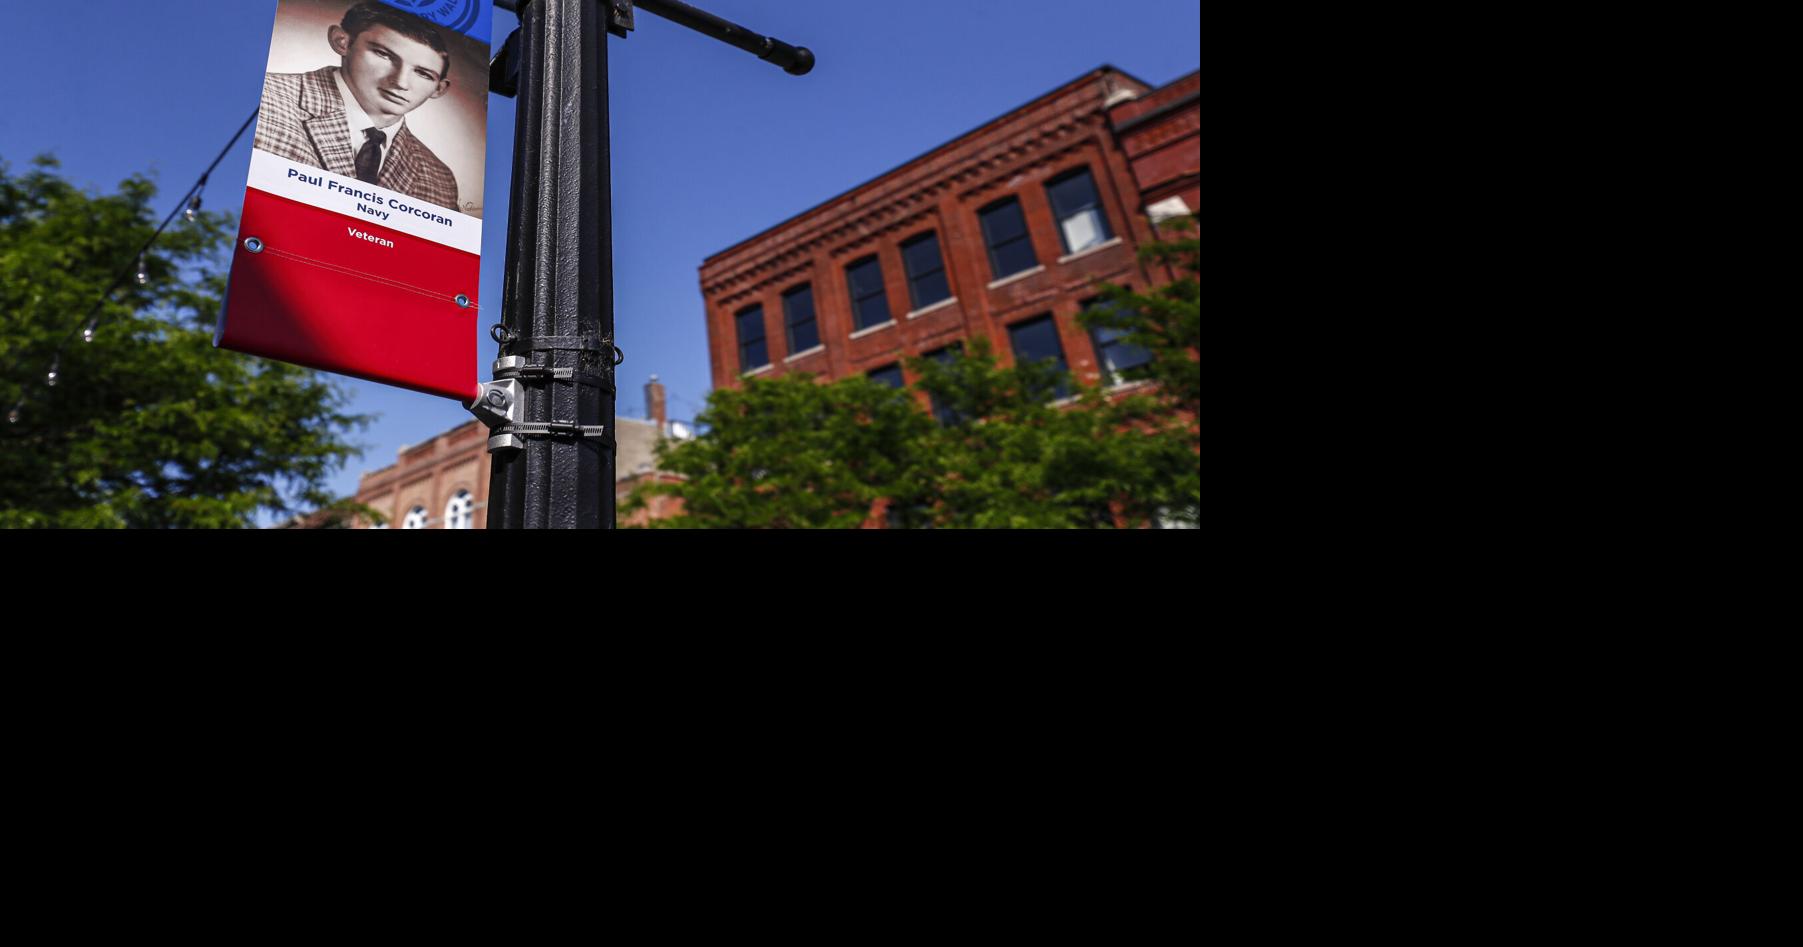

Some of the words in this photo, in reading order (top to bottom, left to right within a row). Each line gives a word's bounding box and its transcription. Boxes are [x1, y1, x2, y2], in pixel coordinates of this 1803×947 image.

[287, 168, 322, 187] Paul
[327, 179, 384, 205] Francis
[388, 198, 453, 227] Corcoran
[356, 202, 390, 221] Navy
[347, 227, 394, 248] Veteran
